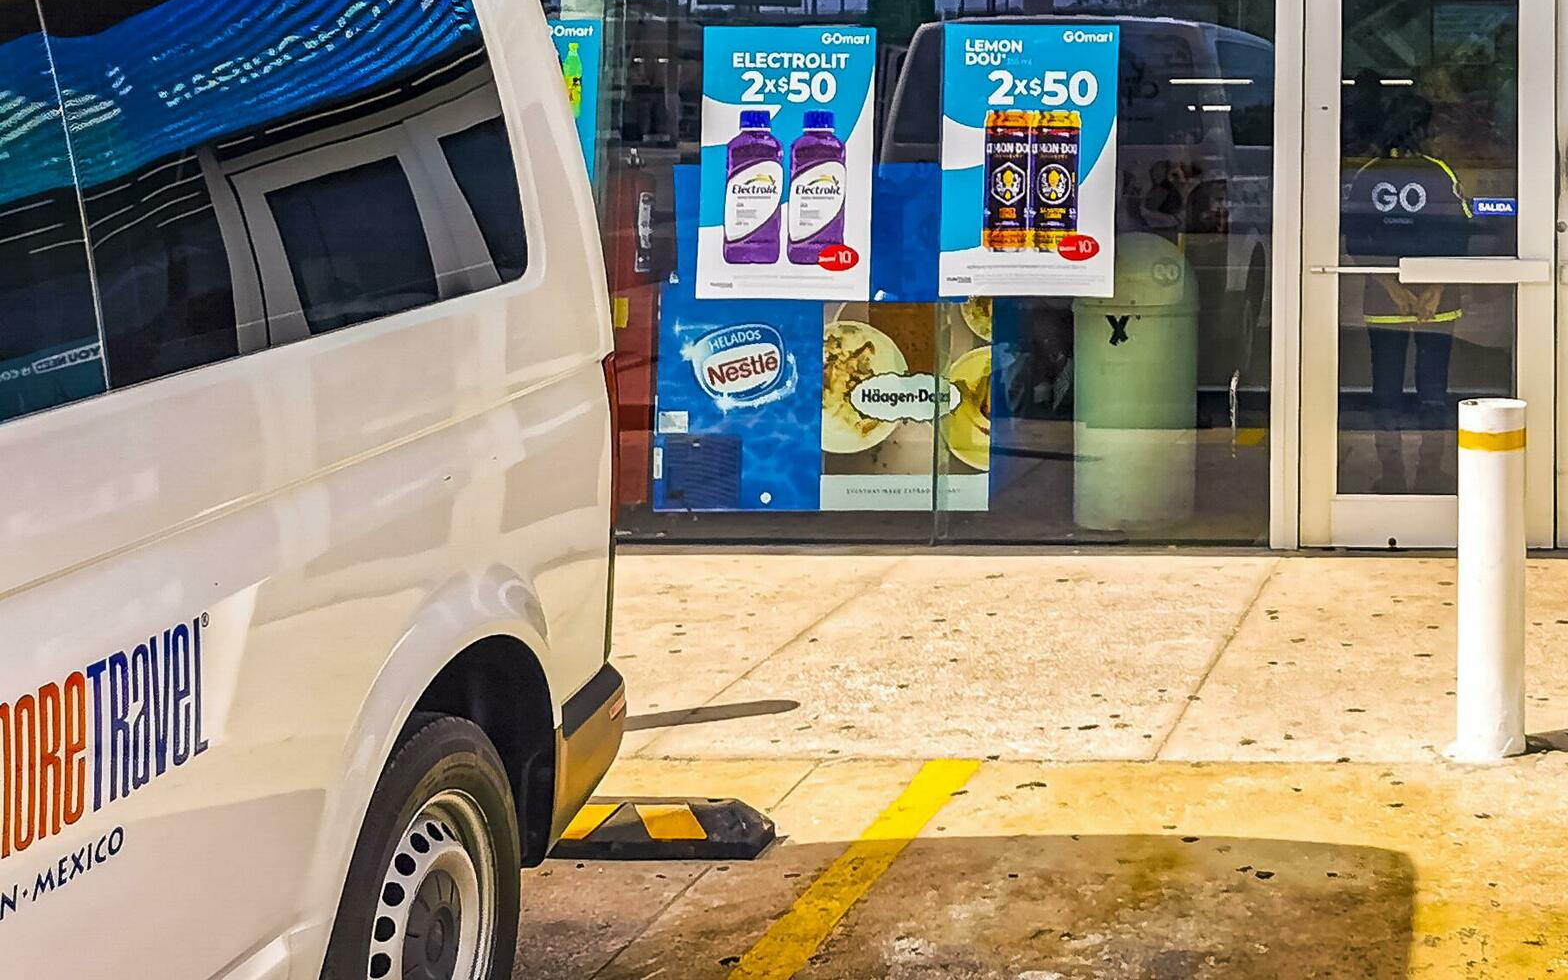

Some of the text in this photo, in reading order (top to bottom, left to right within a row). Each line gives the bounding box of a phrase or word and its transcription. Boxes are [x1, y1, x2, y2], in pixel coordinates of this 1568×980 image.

[821, 33, 870, 45] GOmart
[1063, 31, 1113, 43] GOmart
[965, 39, 1023, 53] LEMON
[732, 52, 850, 69] ELECTROLIT
[1372, 182, 1427, 212] GO
[1478, 203, 1513, 212] SALIDA
[708, 329, 762, 353] HELADOS
